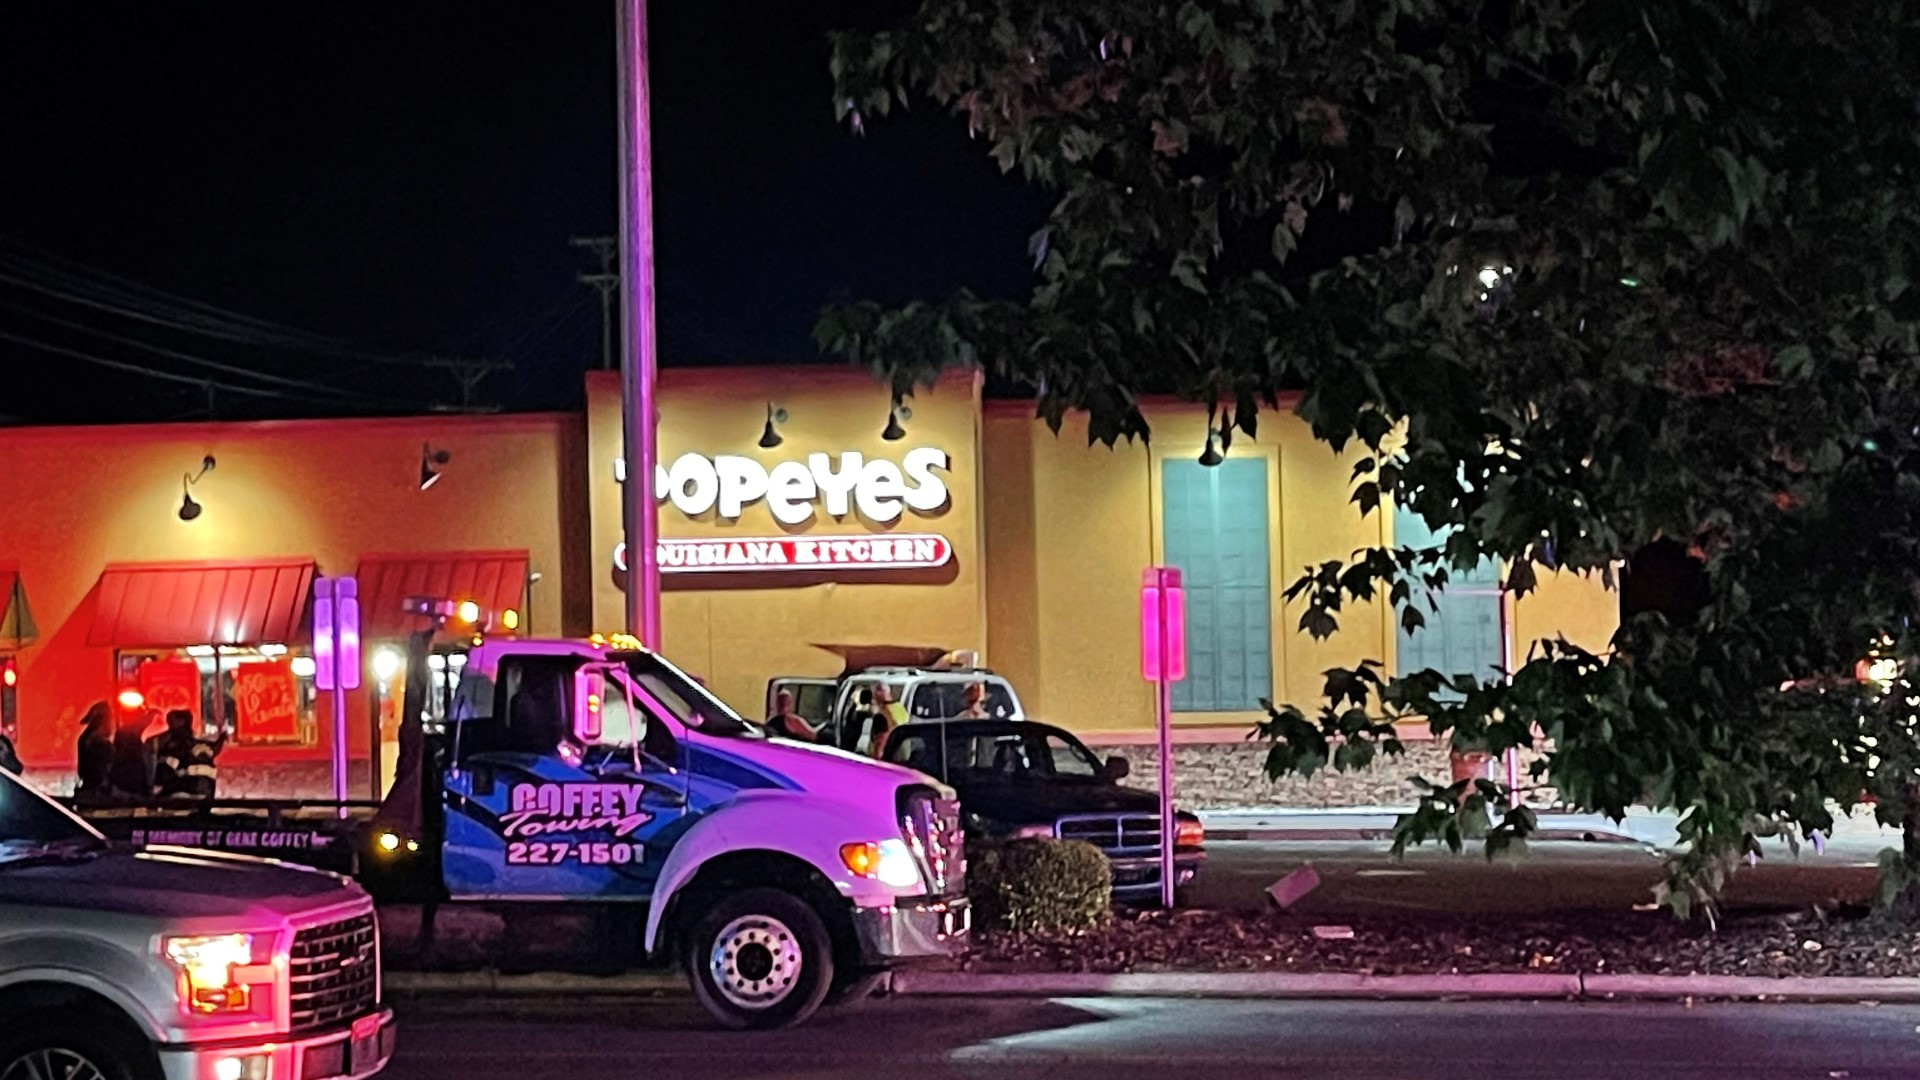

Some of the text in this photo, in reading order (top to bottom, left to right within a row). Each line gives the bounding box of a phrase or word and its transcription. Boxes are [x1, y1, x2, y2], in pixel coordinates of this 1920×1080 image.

[795, 538, 937, 563] KITCHEN
[512, 782, 645, 817] COFFEY
[498, 808, 653, 837] Towing
[508, 841, 645, 865] 227-1501
